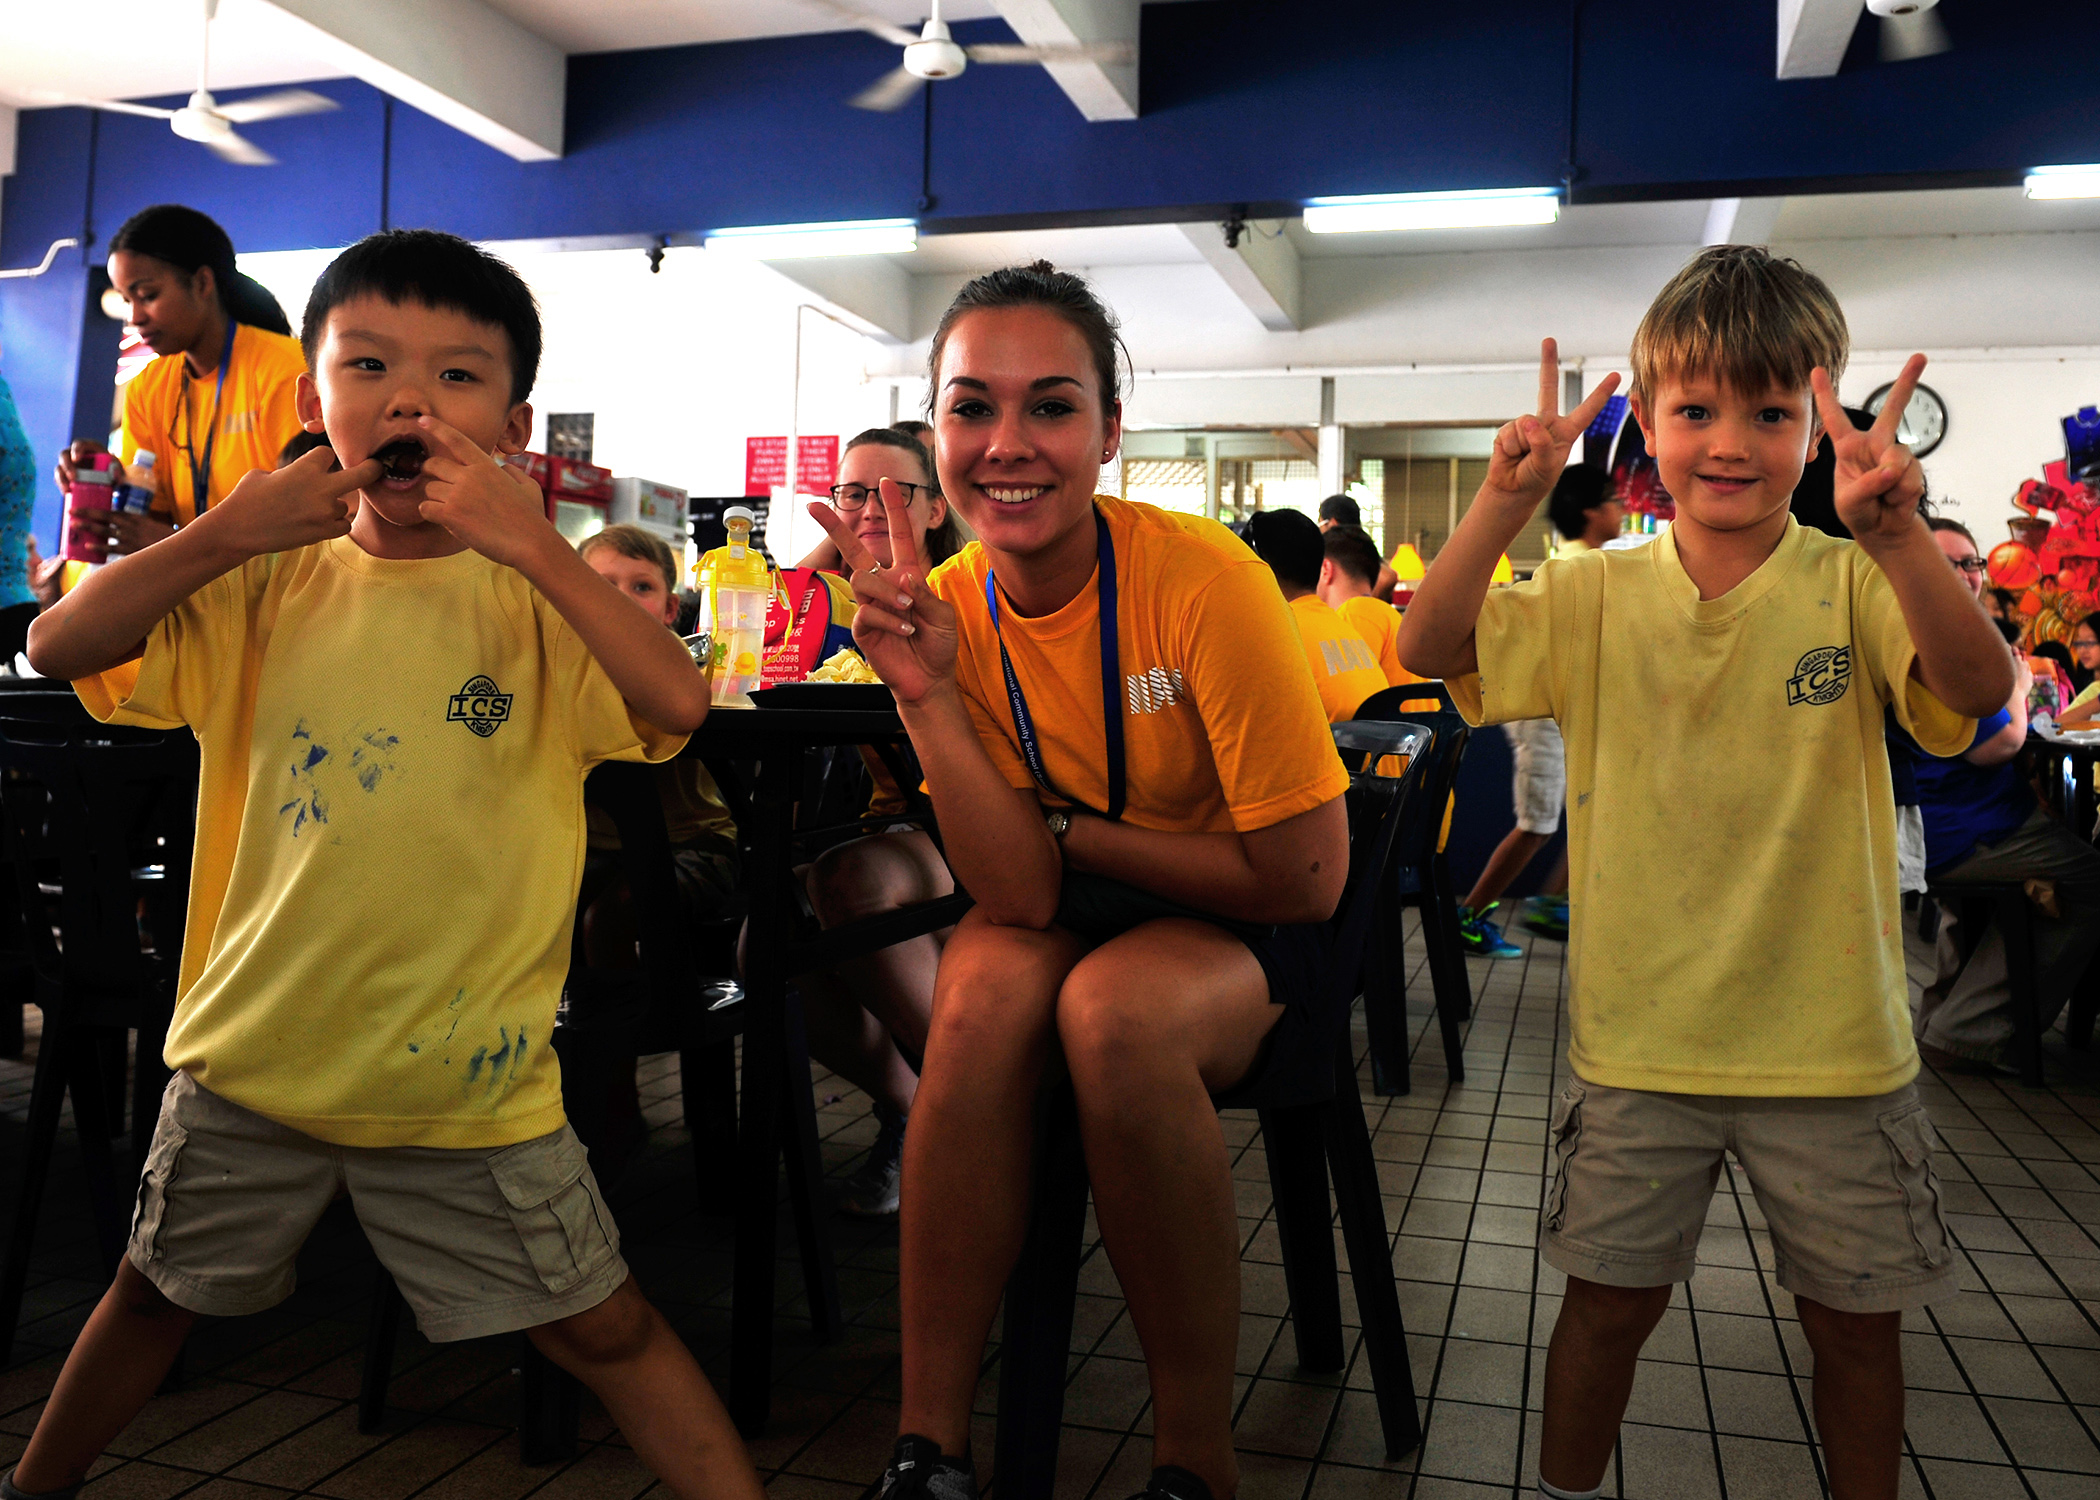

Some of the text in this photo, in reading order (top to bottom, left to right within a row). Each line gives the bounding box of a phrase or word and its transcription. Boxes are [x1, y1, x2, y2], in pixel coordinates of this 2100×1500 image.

[1790, 649, 1850, 700] ICS
[452, 697, 509, 717] ICS
[1012, 692, 1030, 740] Community
[1025, 741, 1039, 770] School
